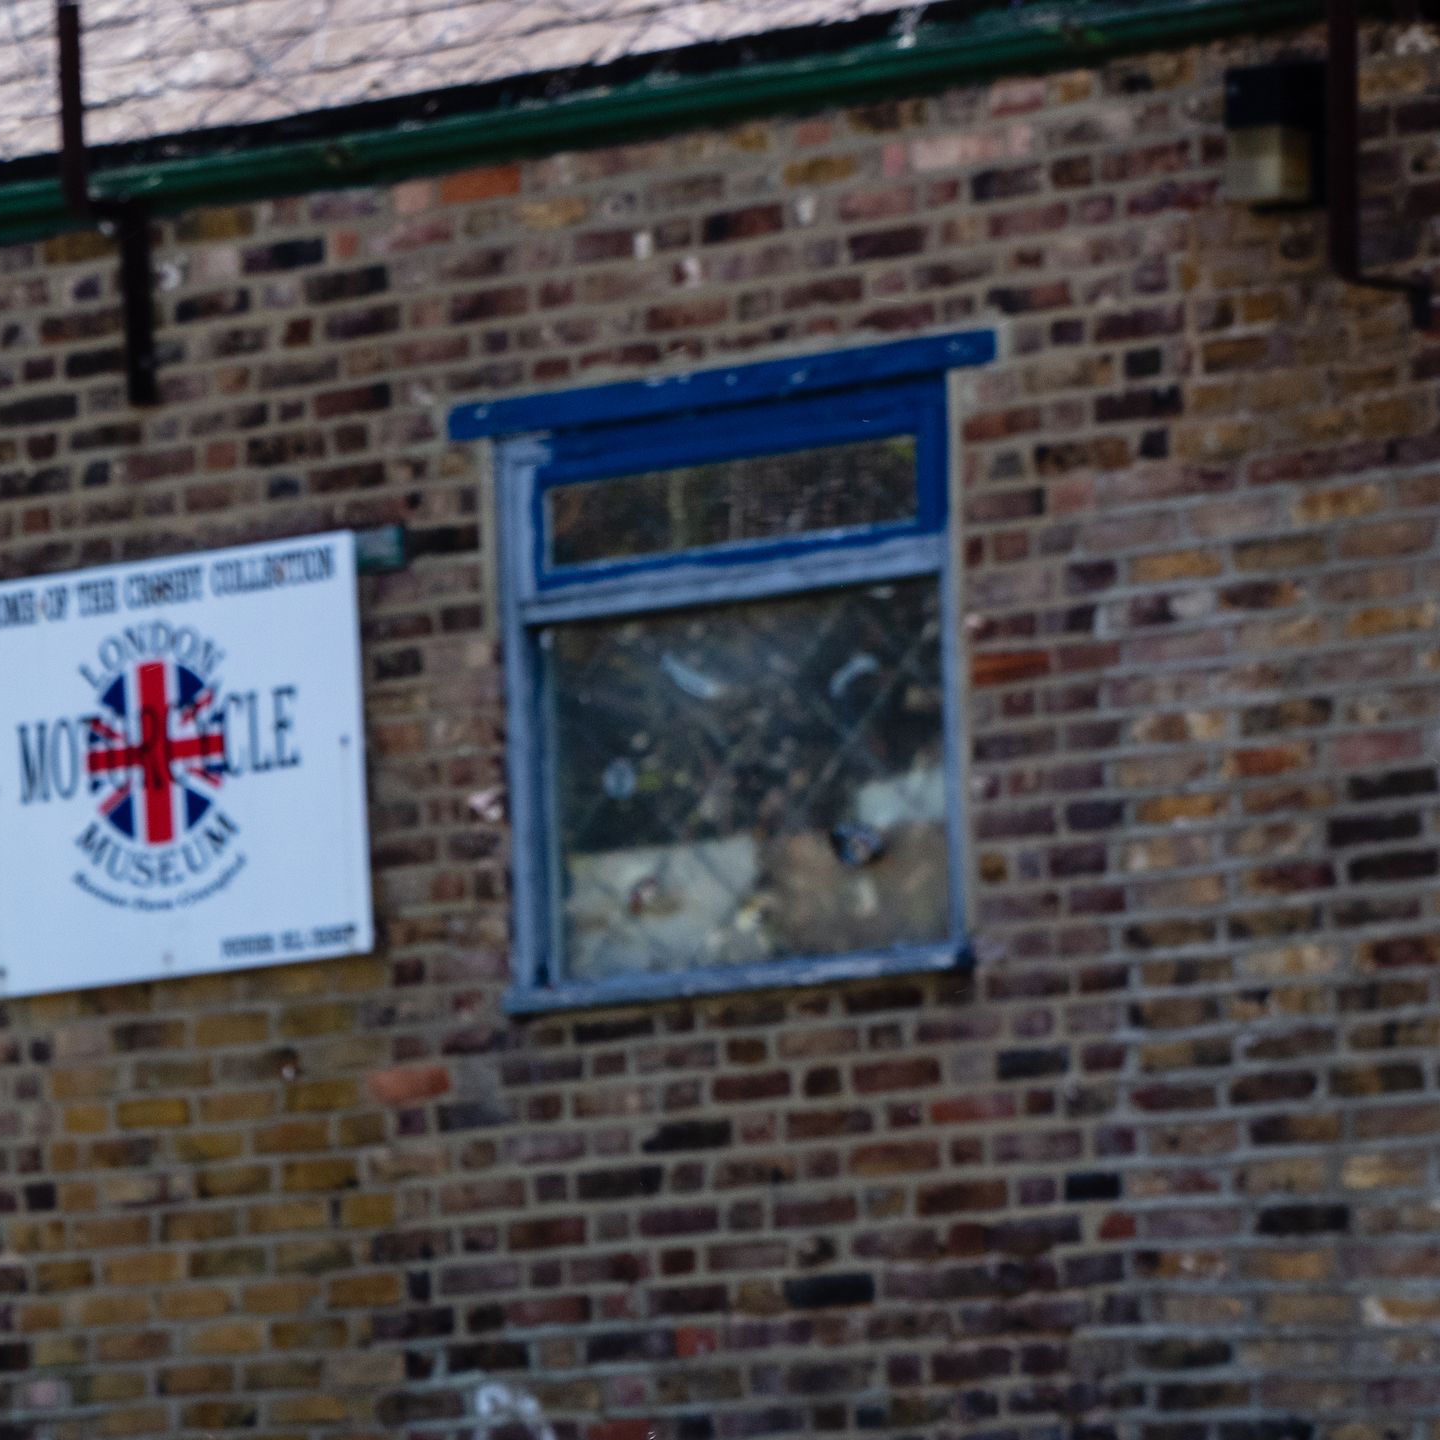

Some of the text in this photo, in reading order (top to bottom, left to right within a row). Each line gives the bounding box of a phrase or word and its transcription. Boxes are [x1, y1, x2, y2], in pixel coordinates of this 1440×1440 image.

[44, 583, 68, 622] OF
[77, 574, 118, 617] THE
[124, 563, 204, 611] CROSBY
[210, 545, 336, 597] COLLECTION
[77, 619, 226, 690] LONDON
[74, 810, 241, 889] MUSEUM
